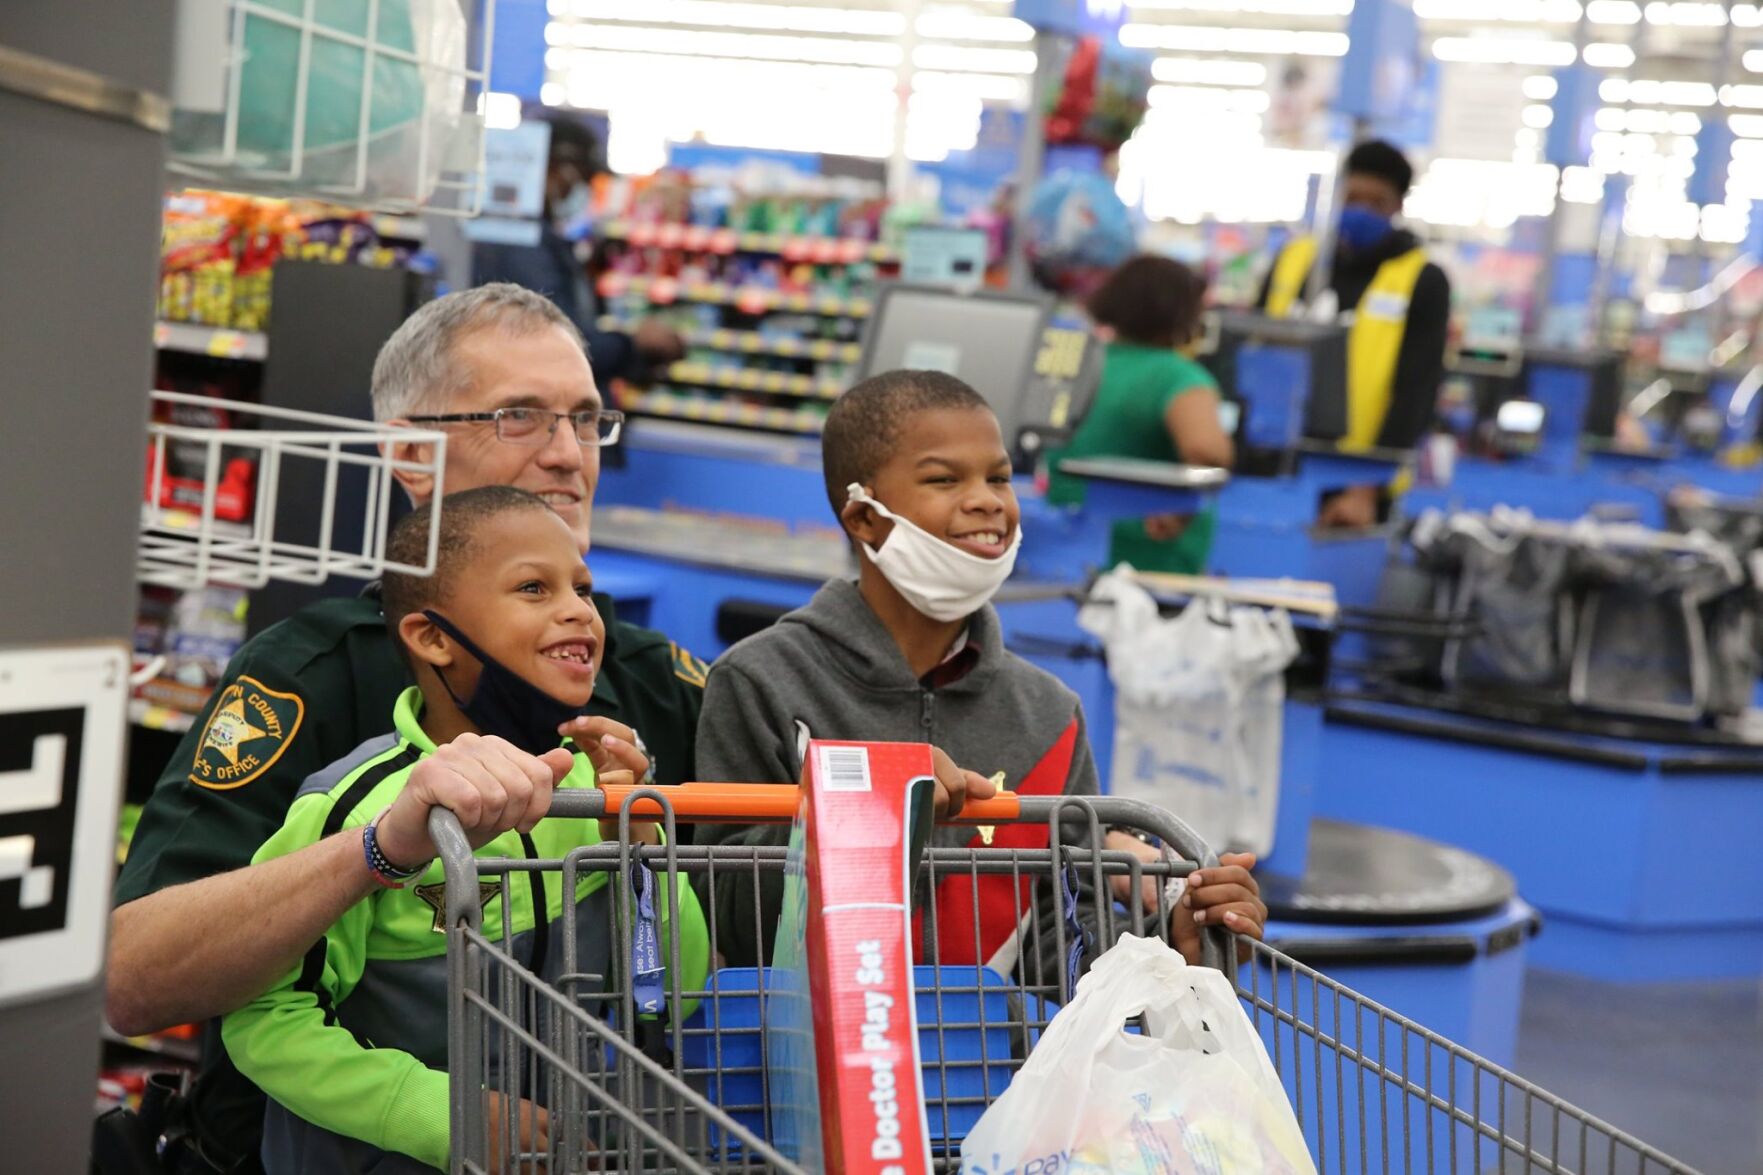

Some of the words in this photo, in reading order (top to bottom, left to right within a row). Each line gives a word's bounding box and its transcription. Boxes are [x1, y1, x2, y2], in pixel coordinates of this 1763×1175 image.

[247, 693, 282, 740] COUNTY
[217, 754, 260, 779] OFFICE
[635, 920, 646, 952] Alway
[855, 940, 885, 985] Set
[860, 990, 895, 1051] Play
[868, 1057, 904, 1160] Doctor
